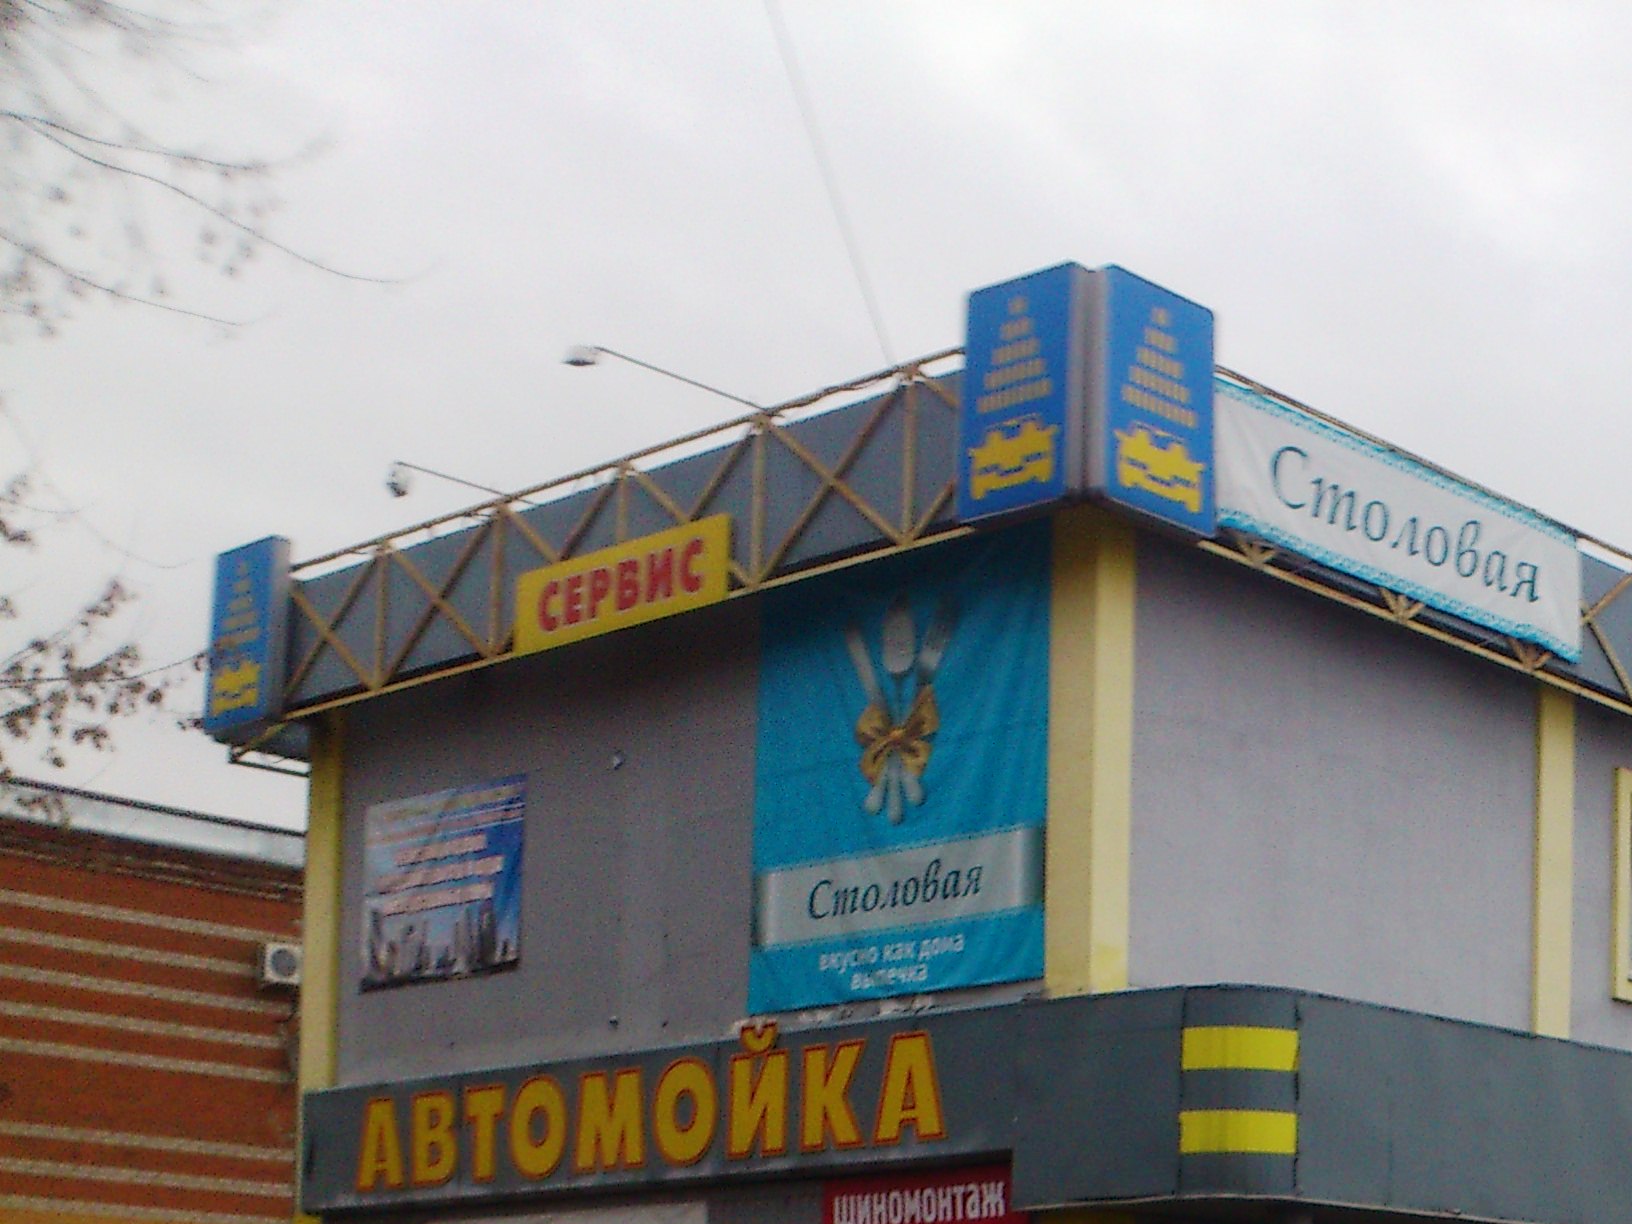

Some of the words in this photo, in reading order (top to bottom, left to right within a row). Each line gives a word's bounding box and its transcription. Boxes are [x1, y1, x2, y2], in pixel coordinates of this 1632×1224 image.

[537, 537, 706, 633] СЕРВИС
[1271, 446, 1539, 602] Столовая
[808, 859, 983, 919] Столовая
[354, 1021, 948, 1193] АВТОМОЙКА
